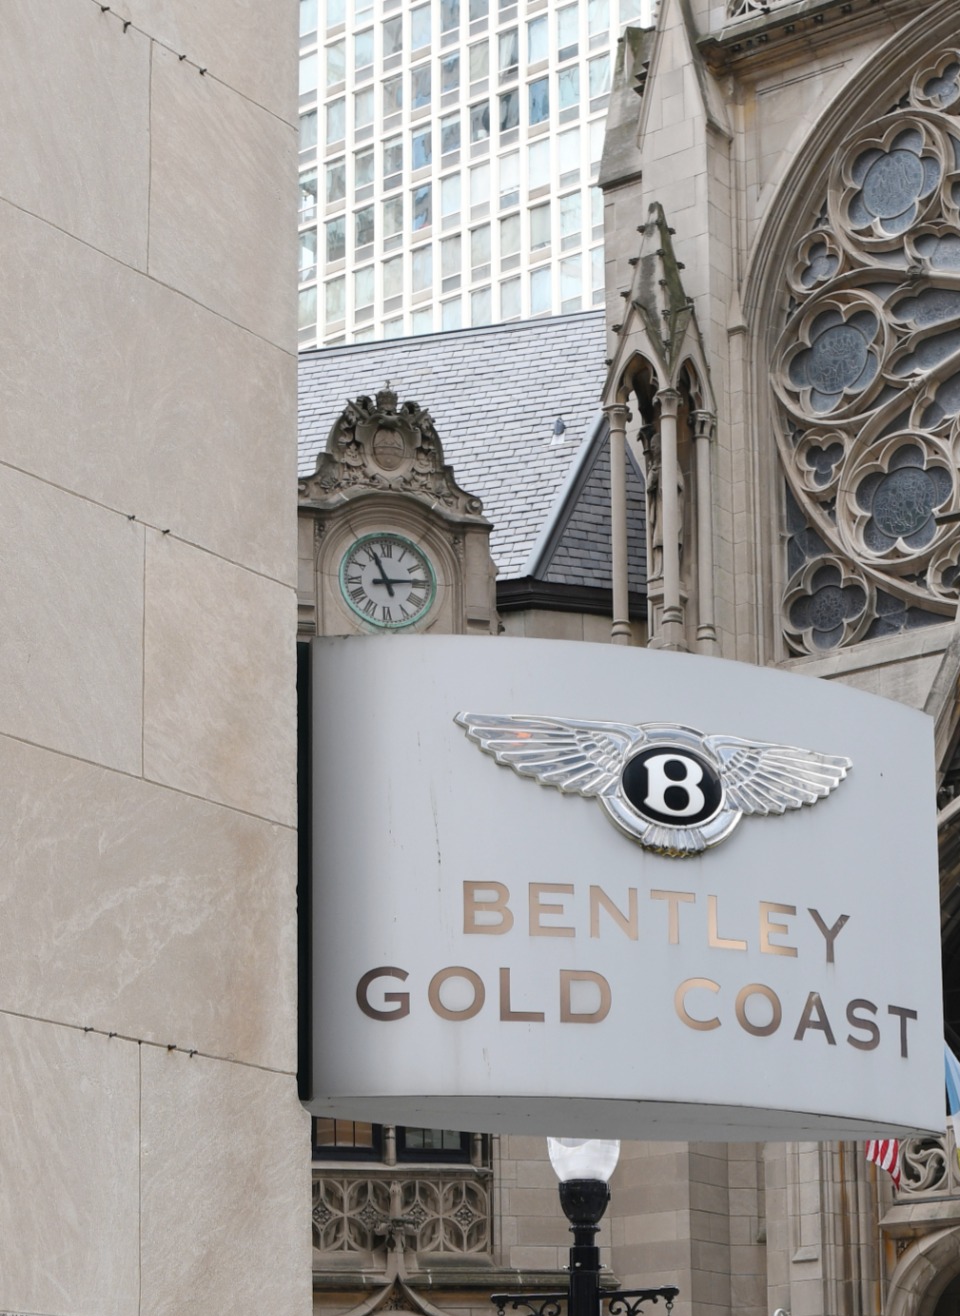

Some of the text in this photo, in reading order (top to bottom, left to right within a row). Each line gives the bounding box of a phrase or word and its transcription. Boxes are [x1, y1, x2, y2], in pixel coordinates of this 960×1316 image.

[380, 543, 393, 558] XII
[643, 754, 705, 817] B
[461, 880, 851, 964] BENTLEY
[355, 965, 918, 1058] GOLD COAST
